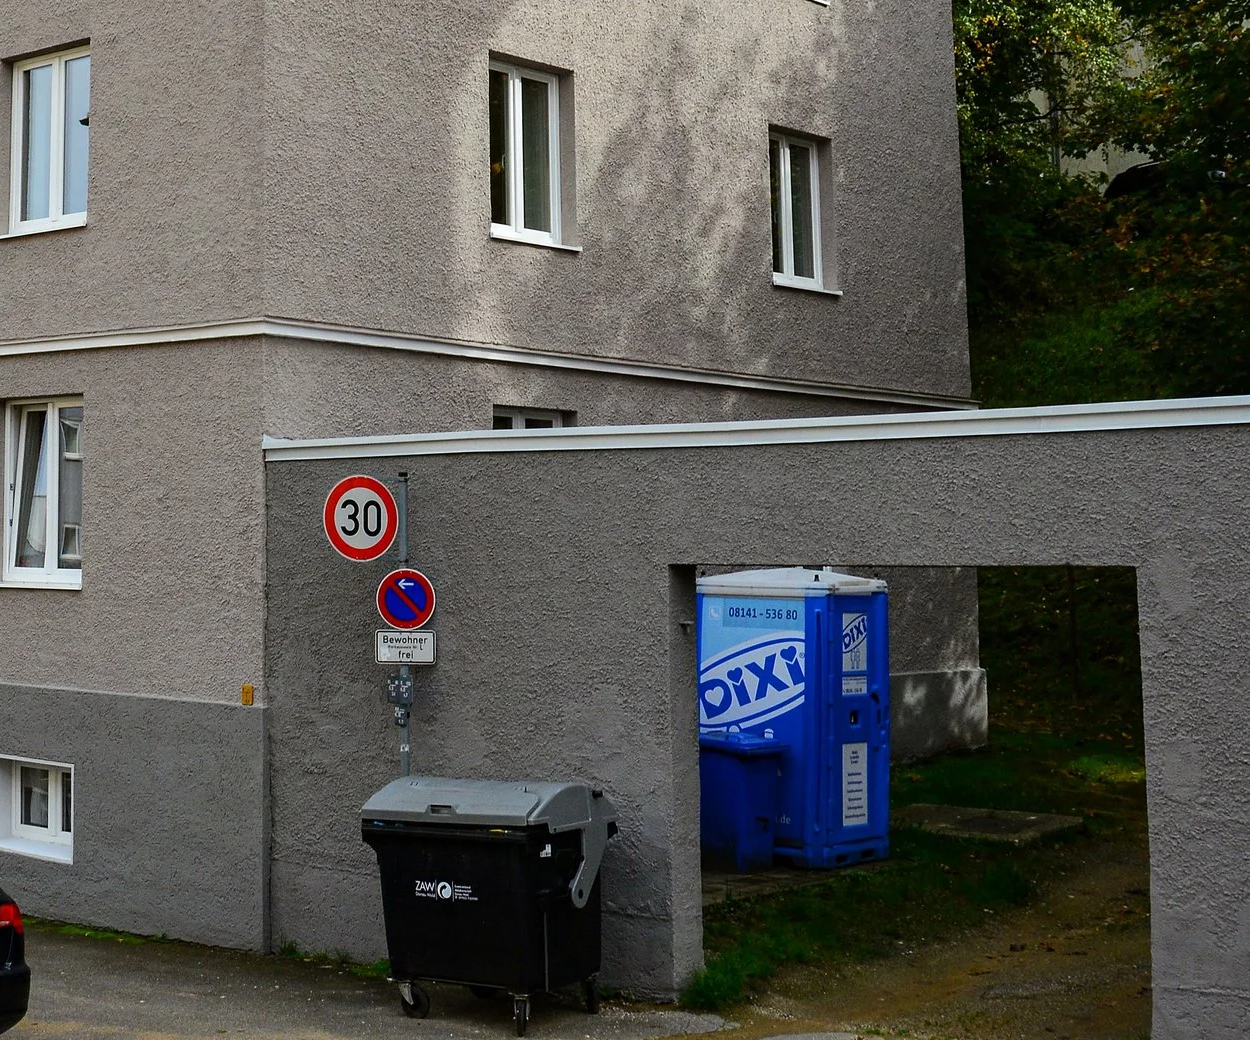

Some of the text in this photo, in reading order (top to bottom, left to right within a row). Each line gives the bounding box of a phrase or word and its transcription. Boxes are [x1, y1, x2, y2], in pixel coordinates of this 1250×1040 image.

[340, 499, 381, 537] 30
[728, 606, 757, 618] 08141
[765, 608, 783, 620] 536
[785, 609, 798, 620] 80
[382, 635, 428, 644] Bewohner
[398, 650, 414, 659] frei
[415, 880, 435, 891] ZAW
